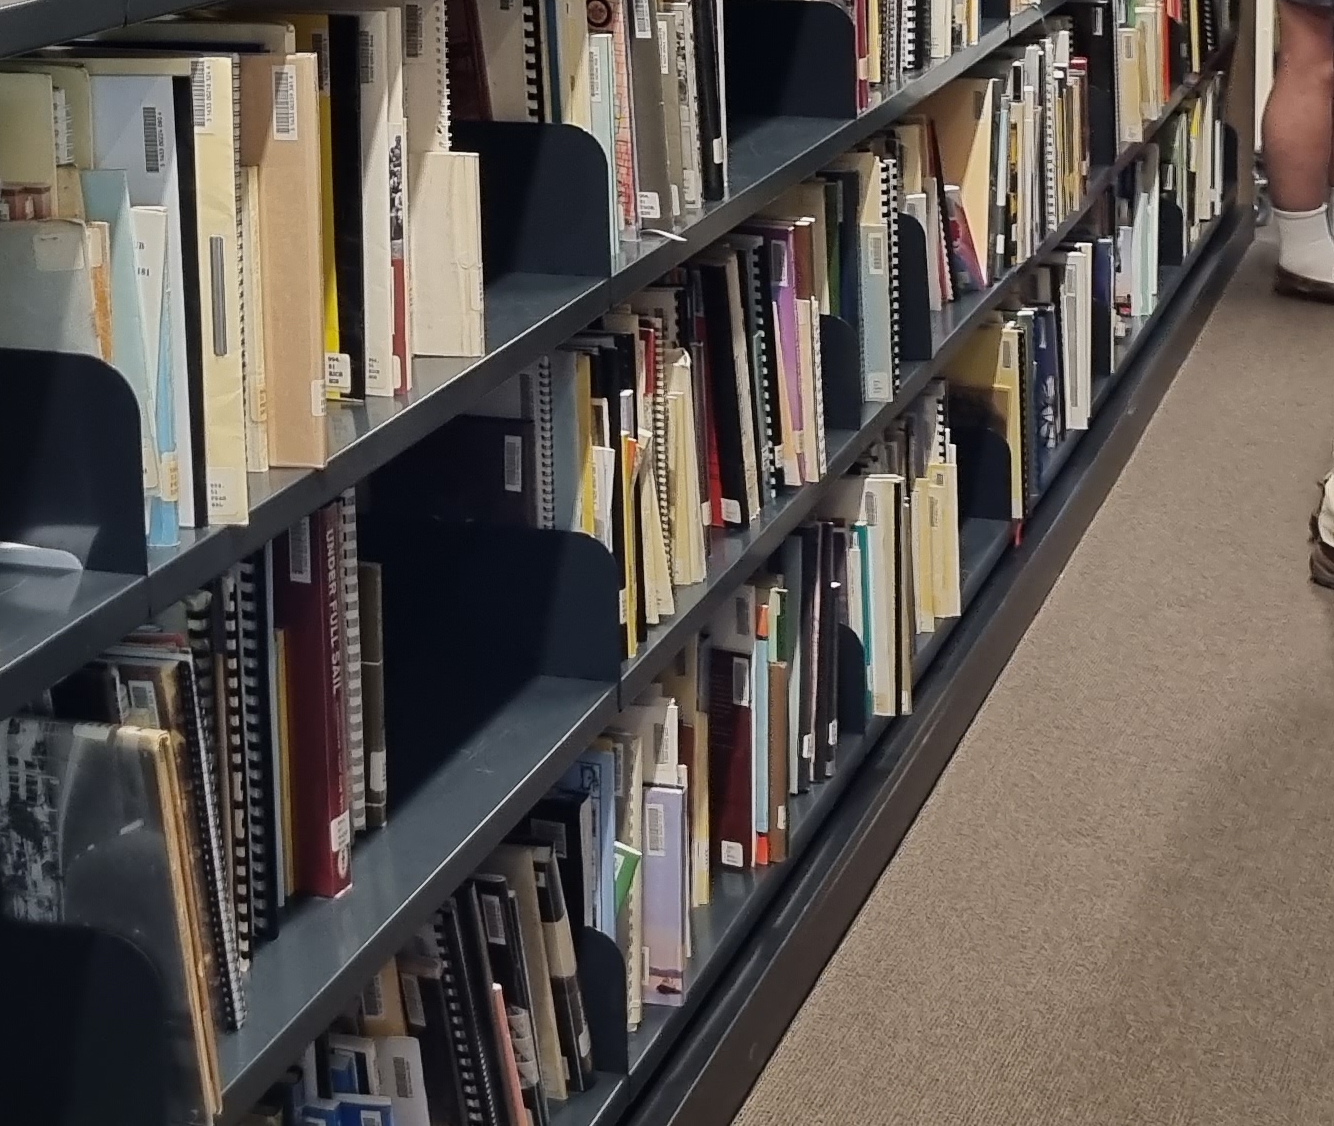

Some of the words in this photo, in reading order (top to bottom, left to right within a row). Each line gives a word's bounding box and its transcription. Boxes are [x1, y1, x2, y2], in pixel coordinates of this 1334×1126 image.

[324, 528, 337, 595] UNDER
[328, 599, 340, 648] FULL
[331, 651, 342, 694] SAIL
